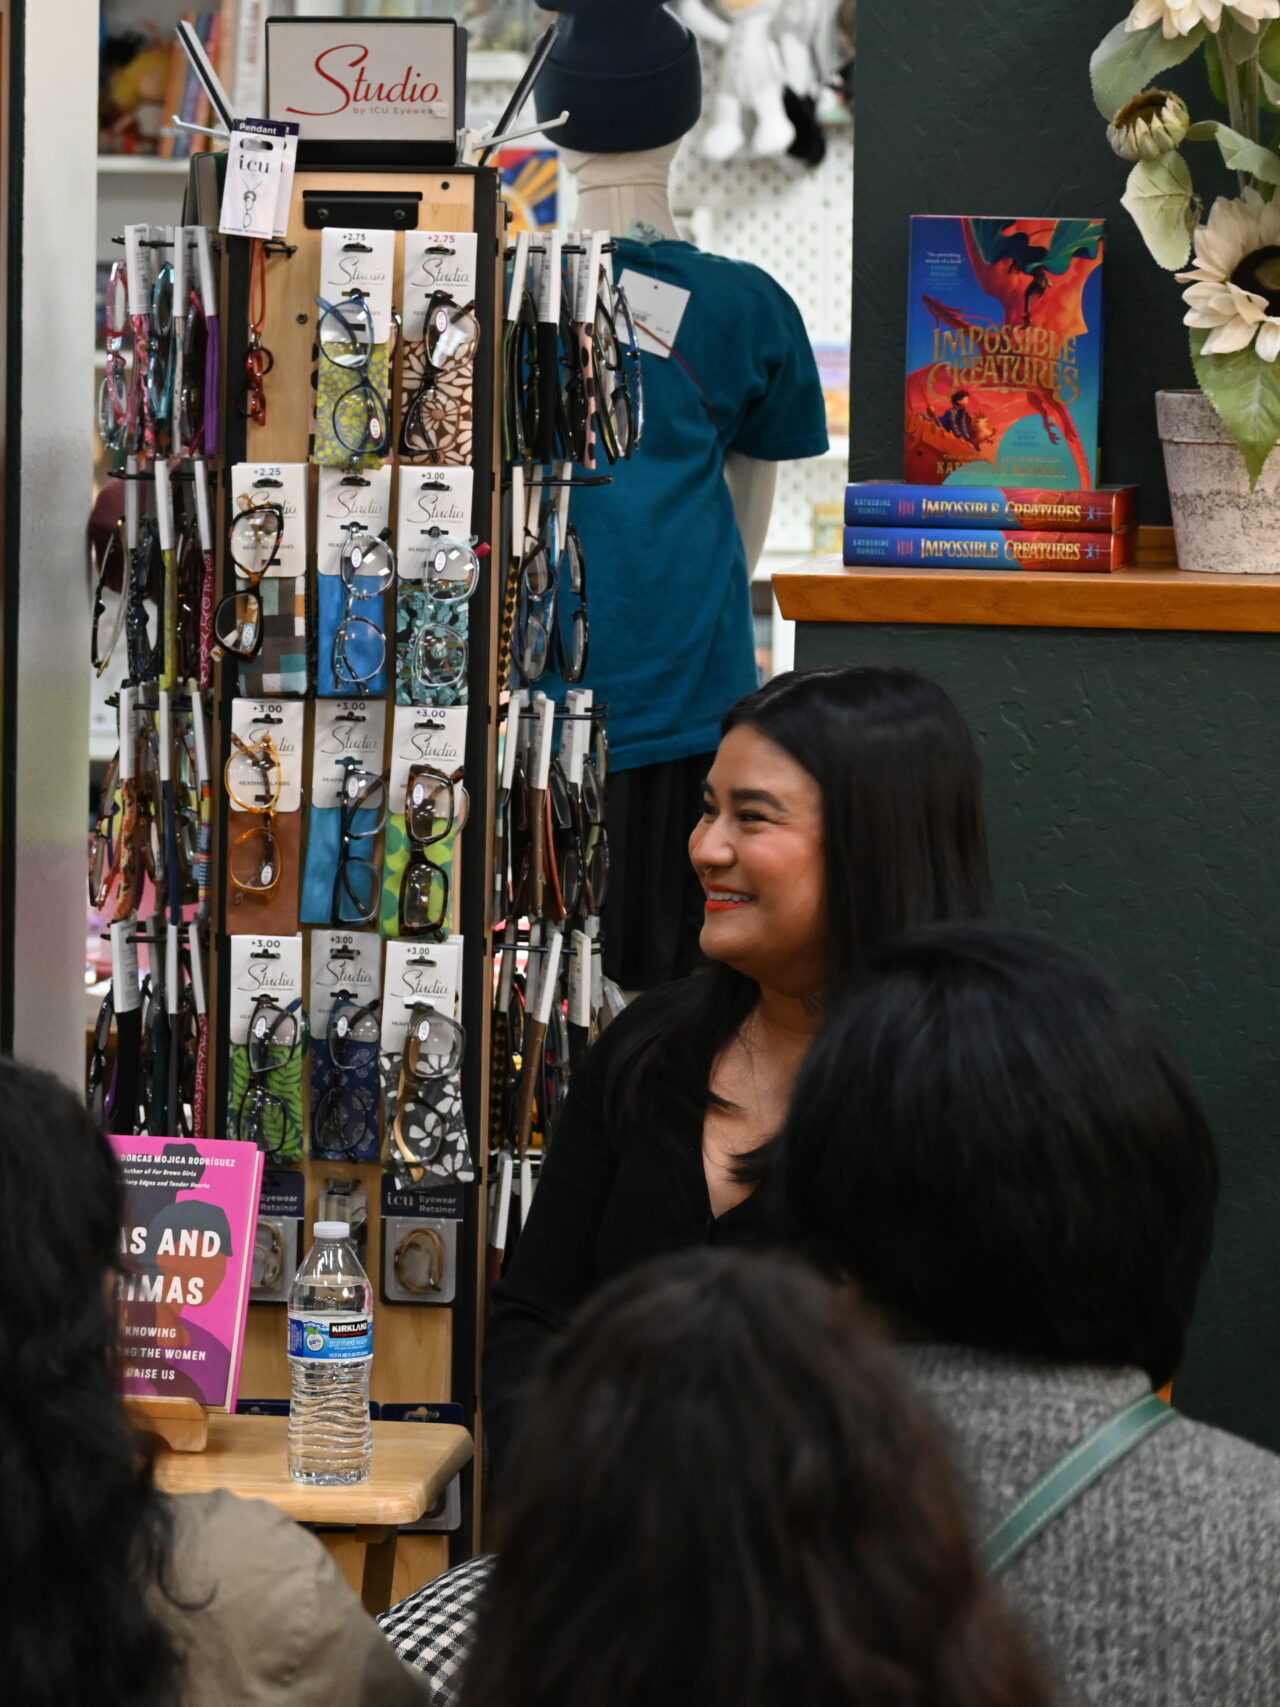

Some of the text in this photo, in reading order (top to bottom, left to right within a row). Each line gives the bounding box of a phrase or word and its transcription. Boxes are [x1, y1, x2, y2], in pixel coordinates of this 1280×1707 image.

[285, 43, 439, 116] Studio
[353, 107, 365, 115] by
[392, 107, 434, 115] Eyewea
[239, 123, 277, 135] Pendant
[239, 155, 270, 173] icu
[342, 233, 366, 241] +2.75
[427, 234, 456, 243] +2.75
[411, 258, 470, 287] Studio
[933, 325, 1078, 364] IMPOSSIBLE
[927, 355, 1080, 405] CREATURES
[253, 468, 282, 476] +2.25
[421, 472, 445, 480] +3.00
[327, 490, 384, 519] Studio
[406, 494, 466, 524] Studio
[922, 498, 1000, 519] IMPOSSIBLE
[1004, 500, 1082, 522] CREATURES
[921, 538, 999, 559] IMPOSSIBLE
[1004, 540, 1081, 561] CREATURES
[253, 705, 283, 713] +3.00
[336, 702, 366, 711] +3.00
[416, 709, 446, 718] +3.00
[321, 725, 378, 754] Studio
[400, 732, 458, 761] Studio
[251, 940, 281, 948] +3.00
[330, 936, 353, 945] +3.00
[406, 947, 430, 956] +3.00
[237, 962, 295, 992] Studio
[316, 959, 373, 987] Studio
[391, 970, 448, 998] Studio
[154, 1155, 186, 1165] MOJICA
[188, 1155, 236, 1168] RODRÍGUEZ
[139, 1179, 156, 1187] Edges
[260, 1195, 298, 1203] Eyewear
[387, 1192, 457, 1207] icu Eyewear
[261, 1204, 298, 1212] Retainer
[419, 1205, 457, 1214] Retainer
[157, 1228, 222, 1258] AND
[125, 1326, 177, 1339] KNOWING
[140, 1347, 161, 1359] THE
[165, 1348, 206, 1361] WOMEN
[161, 1370, 176, 1380] US
